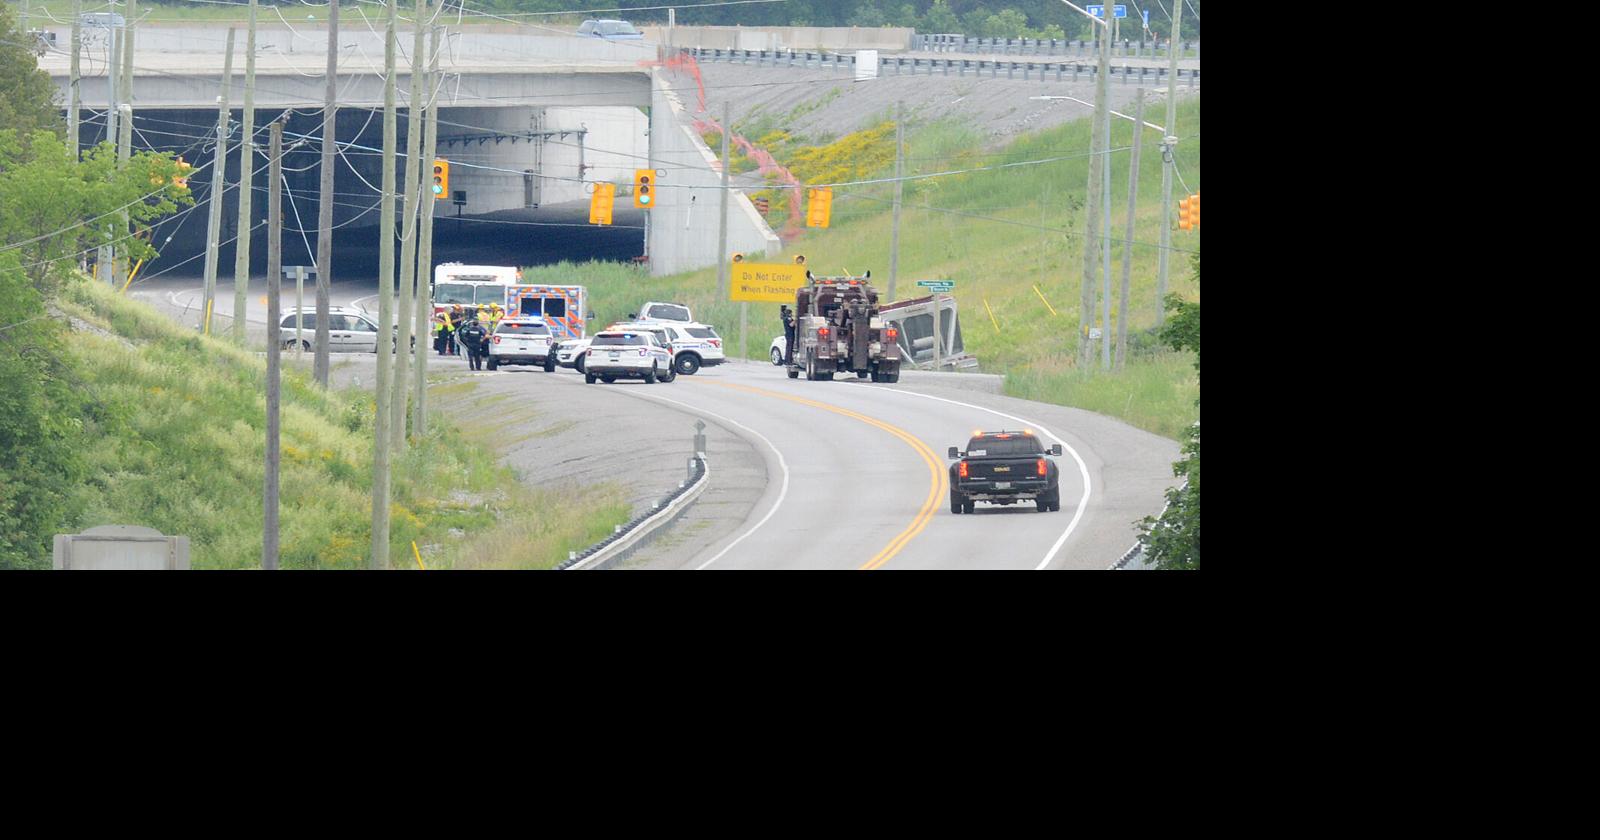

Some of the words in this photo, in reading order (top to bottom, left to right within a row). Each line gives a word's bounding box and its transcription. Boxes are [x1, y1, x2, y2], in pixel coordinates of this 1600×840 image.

[742, 272, 752, 280] Do
[755, 272, 769, 281] Not
[771, 273, 793, 281] Enter
[741, 285, 761, 293] When
[763, 286, 796, 296] Flashing
